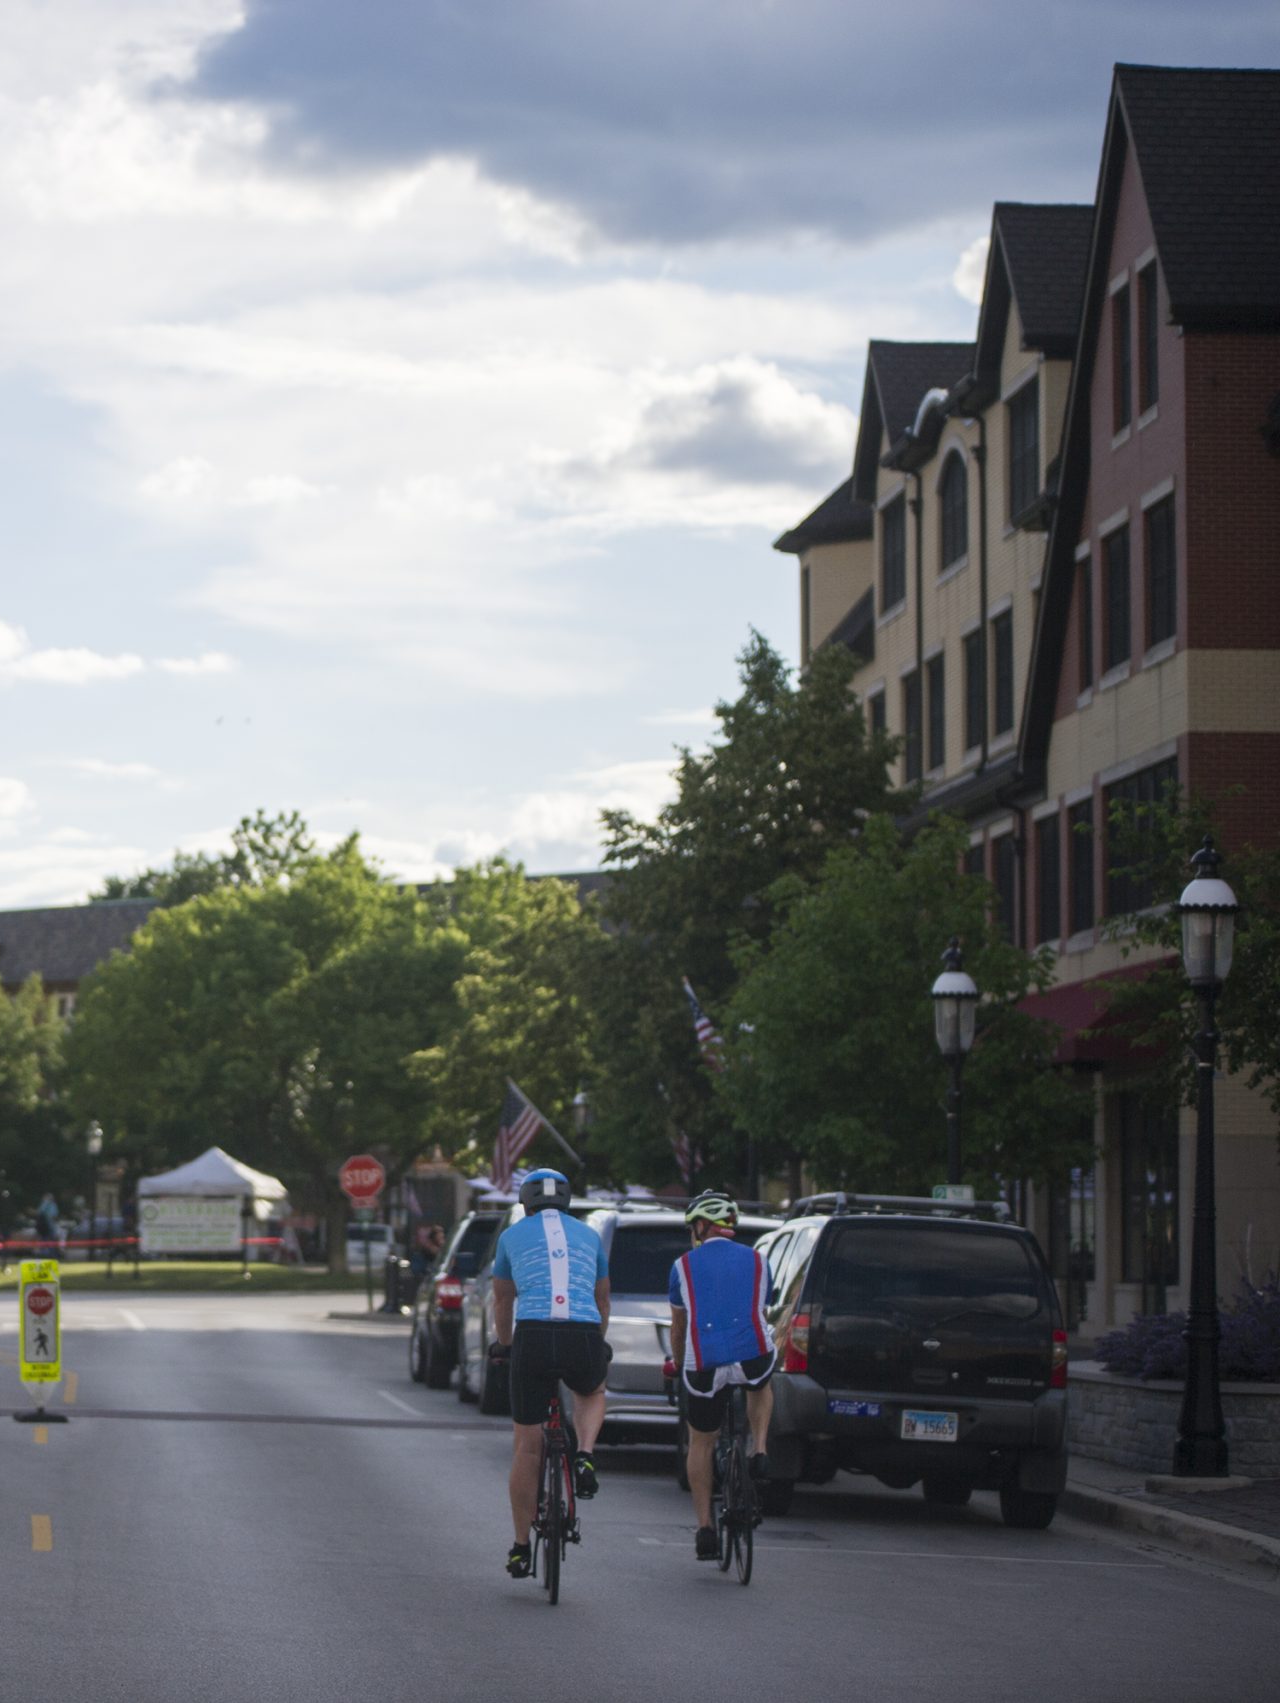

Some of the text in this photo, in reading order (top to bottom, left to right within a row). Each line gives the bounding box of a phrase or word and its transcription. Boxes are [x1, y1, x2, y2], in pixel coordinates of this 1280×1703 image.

[343, 1168, 381, 1188] STOP
[29, 1296, 52, 1307] STOP
[923, 1418, 955, 1436] 15665
